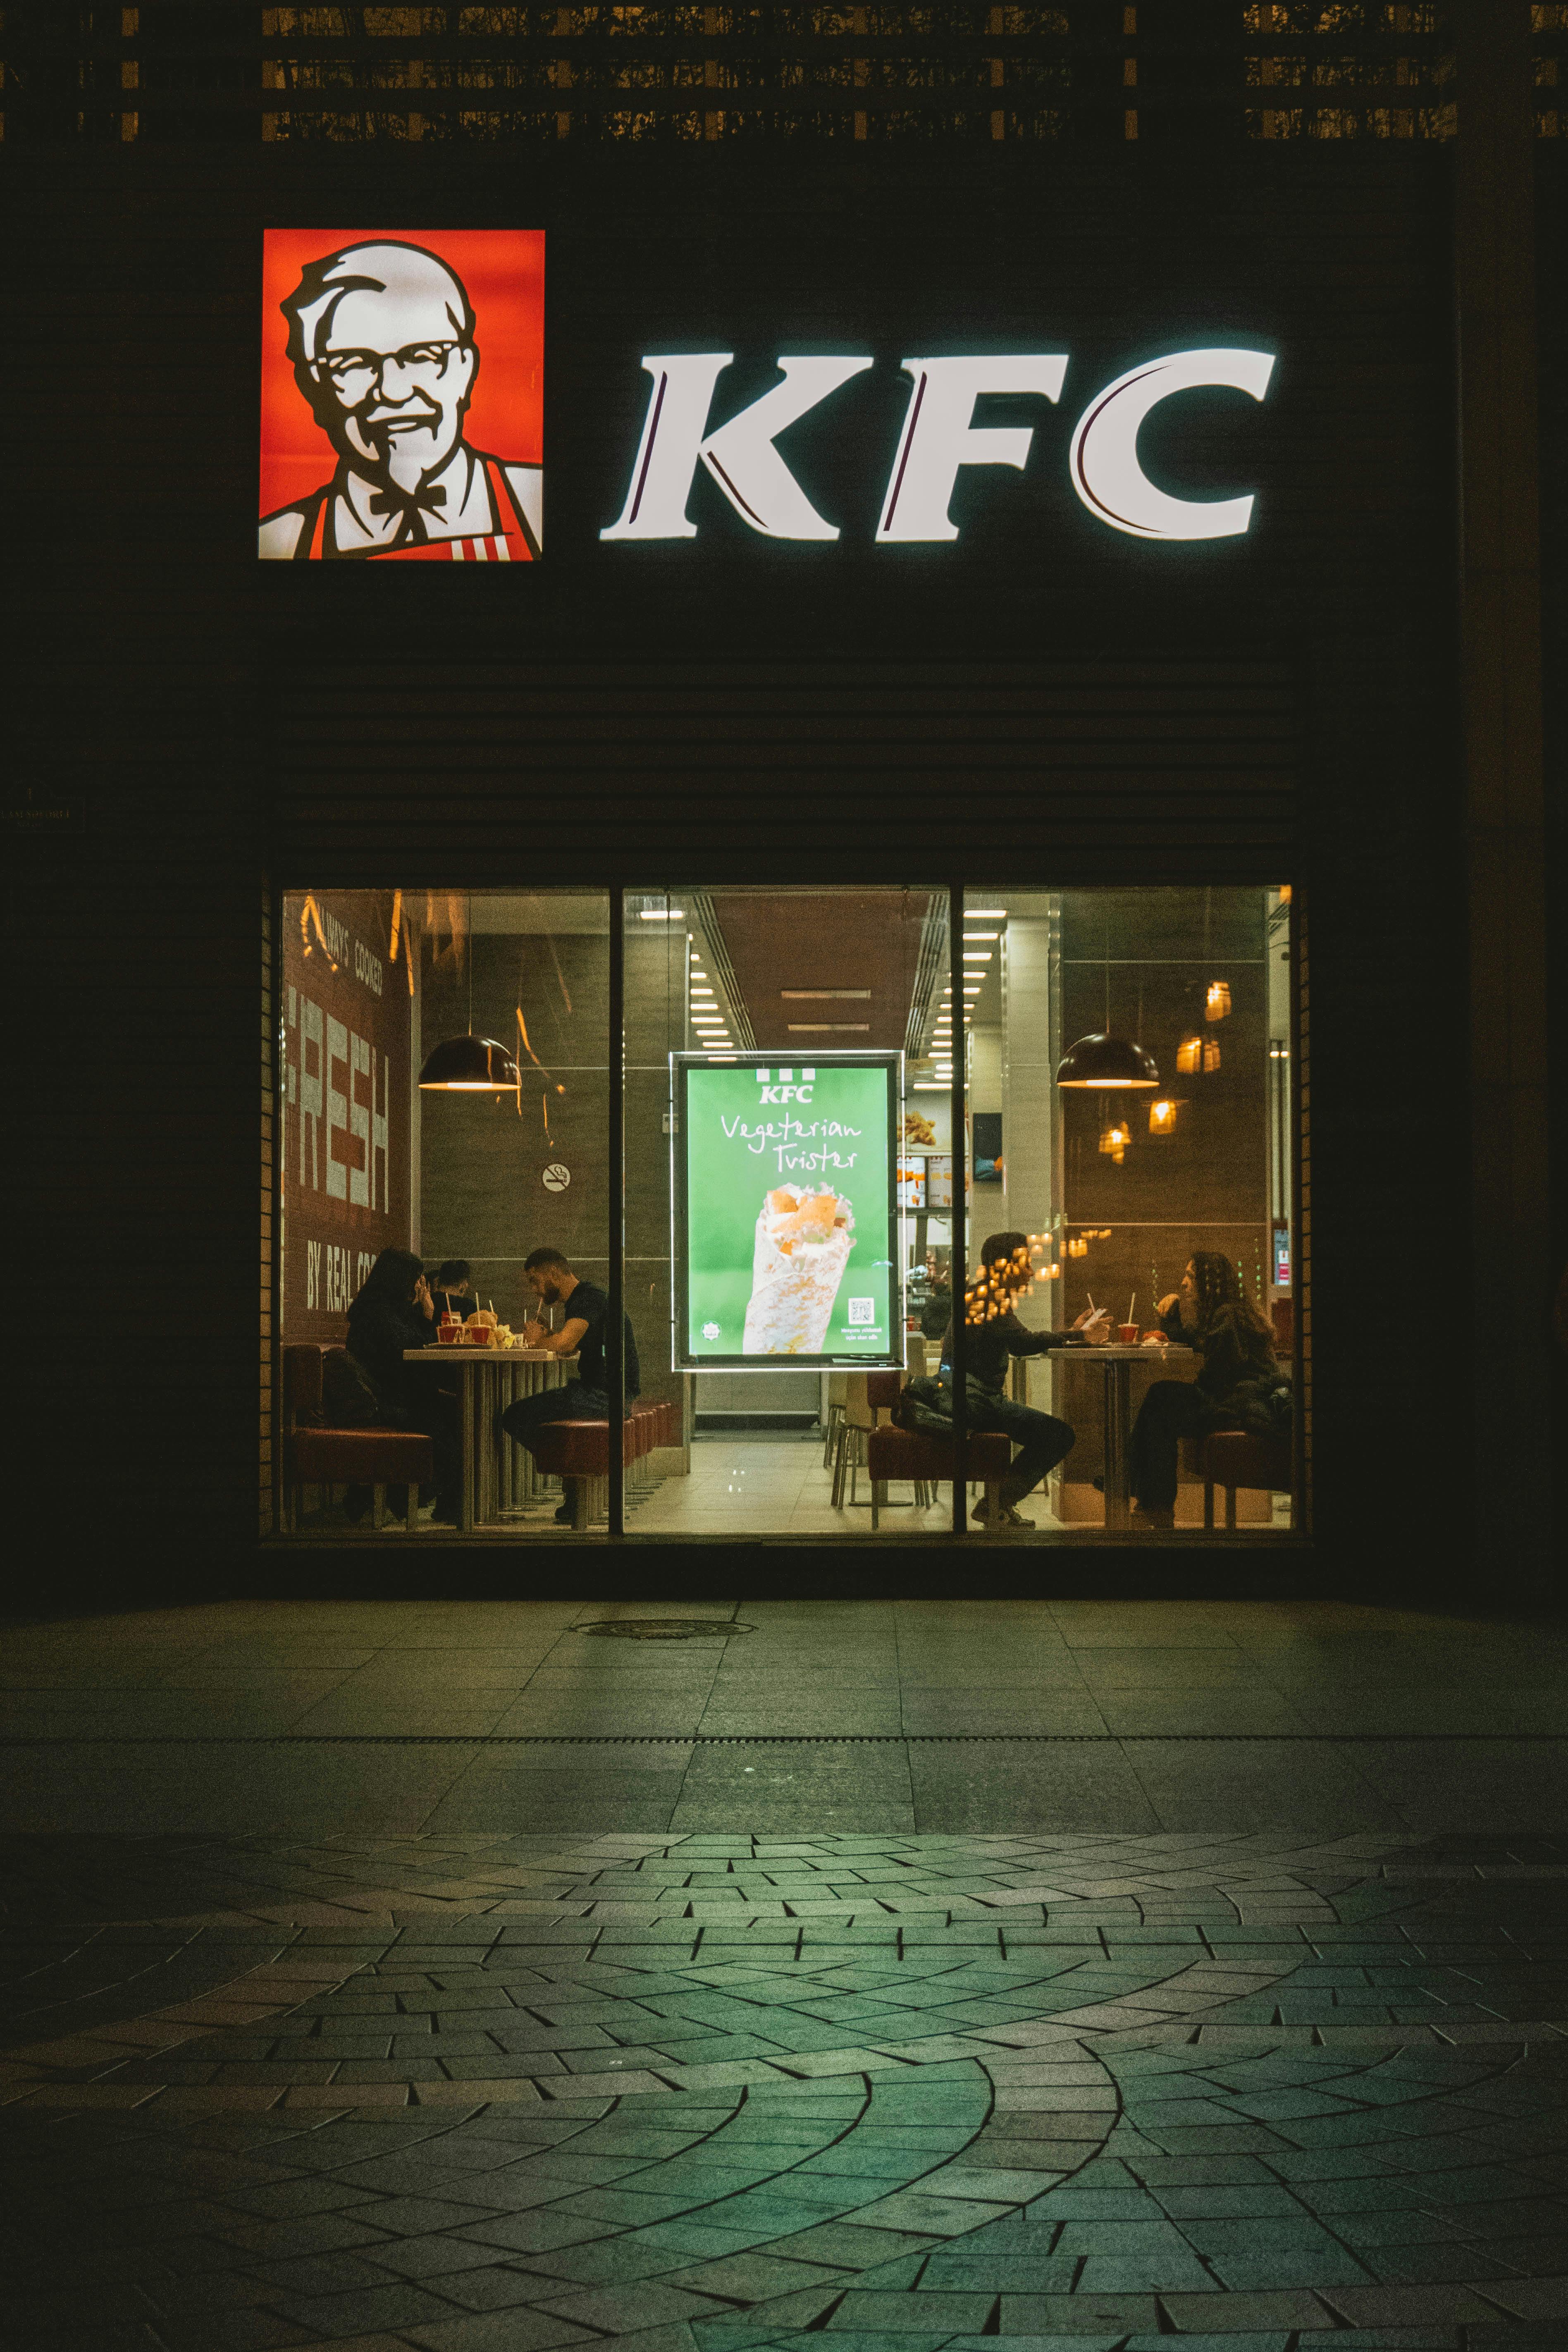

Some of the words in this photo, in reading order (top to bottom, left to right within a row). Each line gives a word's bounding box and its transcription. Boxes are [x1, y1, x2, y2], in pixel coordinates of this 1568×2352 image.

[599, 348, 1276, 541] KFC
[355, 938, 382, 996] COOKED
[288, 984, 389, 1214] RESH
[759, 1085, 814, 1104] KFC
[721, 1112, 862, 1153] Vegeterian
[773, 1143, 858, 1172] Tvister
[307, 1240, 321, 1310] BY
[327, 1244, 353, 1312] REAL
